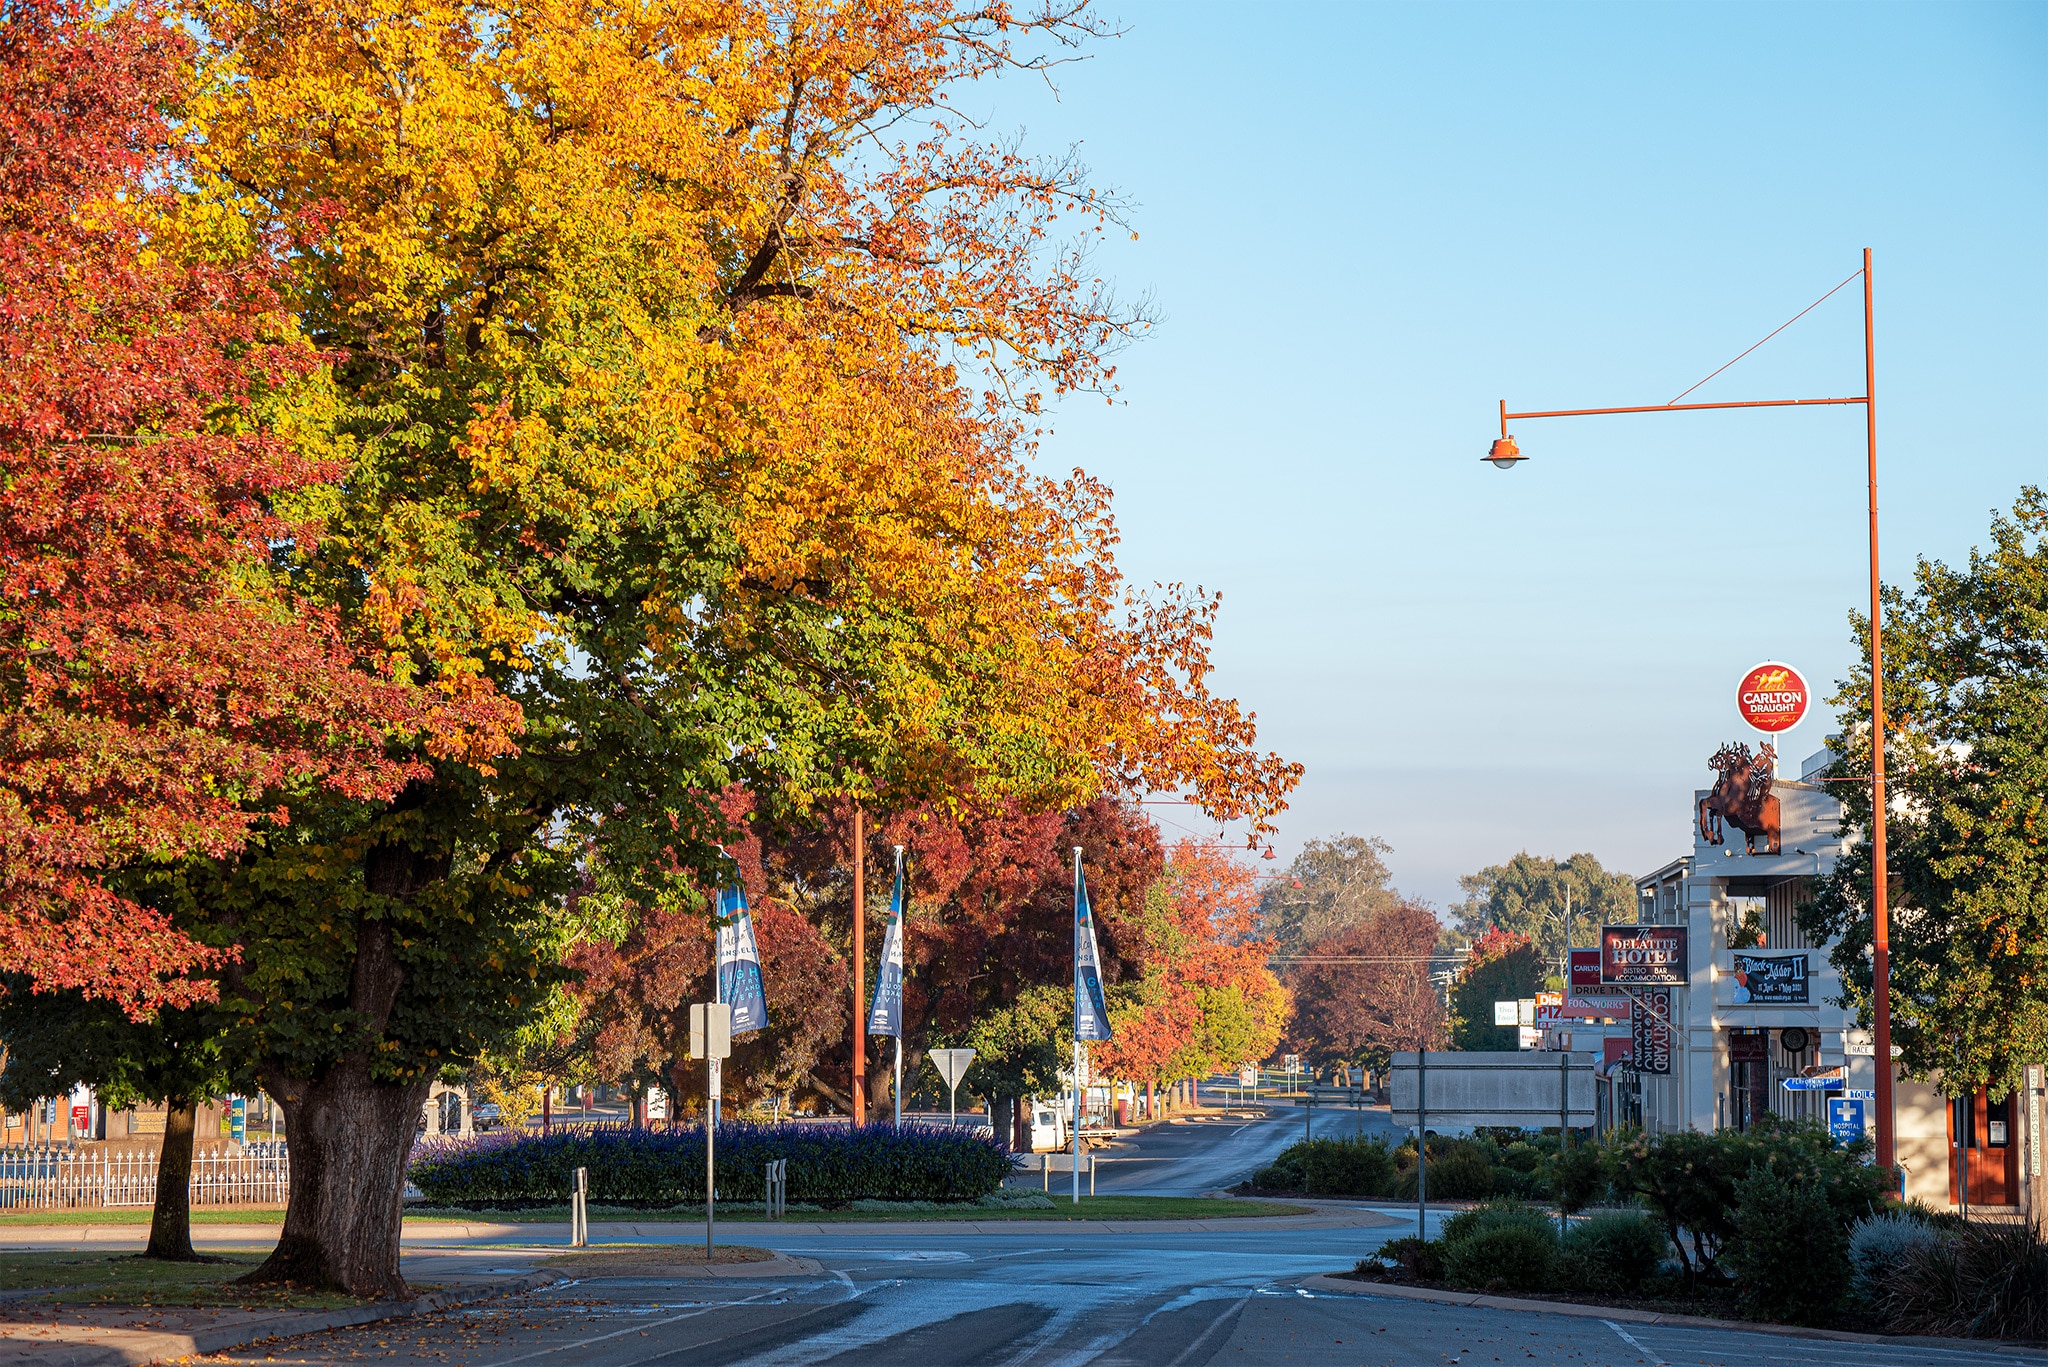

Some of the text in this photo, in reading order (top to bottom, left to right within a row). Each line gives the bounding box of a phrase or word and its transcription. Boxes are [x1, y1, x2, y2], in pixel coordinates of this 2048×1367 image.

[1743, 692, 1802, 704] CARLTON
[1750, 704, 1795, 712] DRAUGHT
[1636, 928, 1653, 940] The
[1612, 939, 1678, 950] DELATITE
[1612, 950, 1678, 964] HOTEL
[1623, 967, 1668, 975] BISTRO BAR
[1742, 956, 1805, 980] Black Adder II
[1614, 974, 1677, 982] ACCOMMODATION
[1575, 986, 1605, 994] DRIVE
[1538, 1006, 1562, 1019] PIZ
[1654, 994, 1668, 1071] COURTYARD
[1852, 1046, 1869, 1054] RACE
[1834, 1123, 1860, 1131] HOSPITAL
[2032, 1123, 2039, 1134] OF
[2032, 1135, 2040, 1175] MANSFIELD
